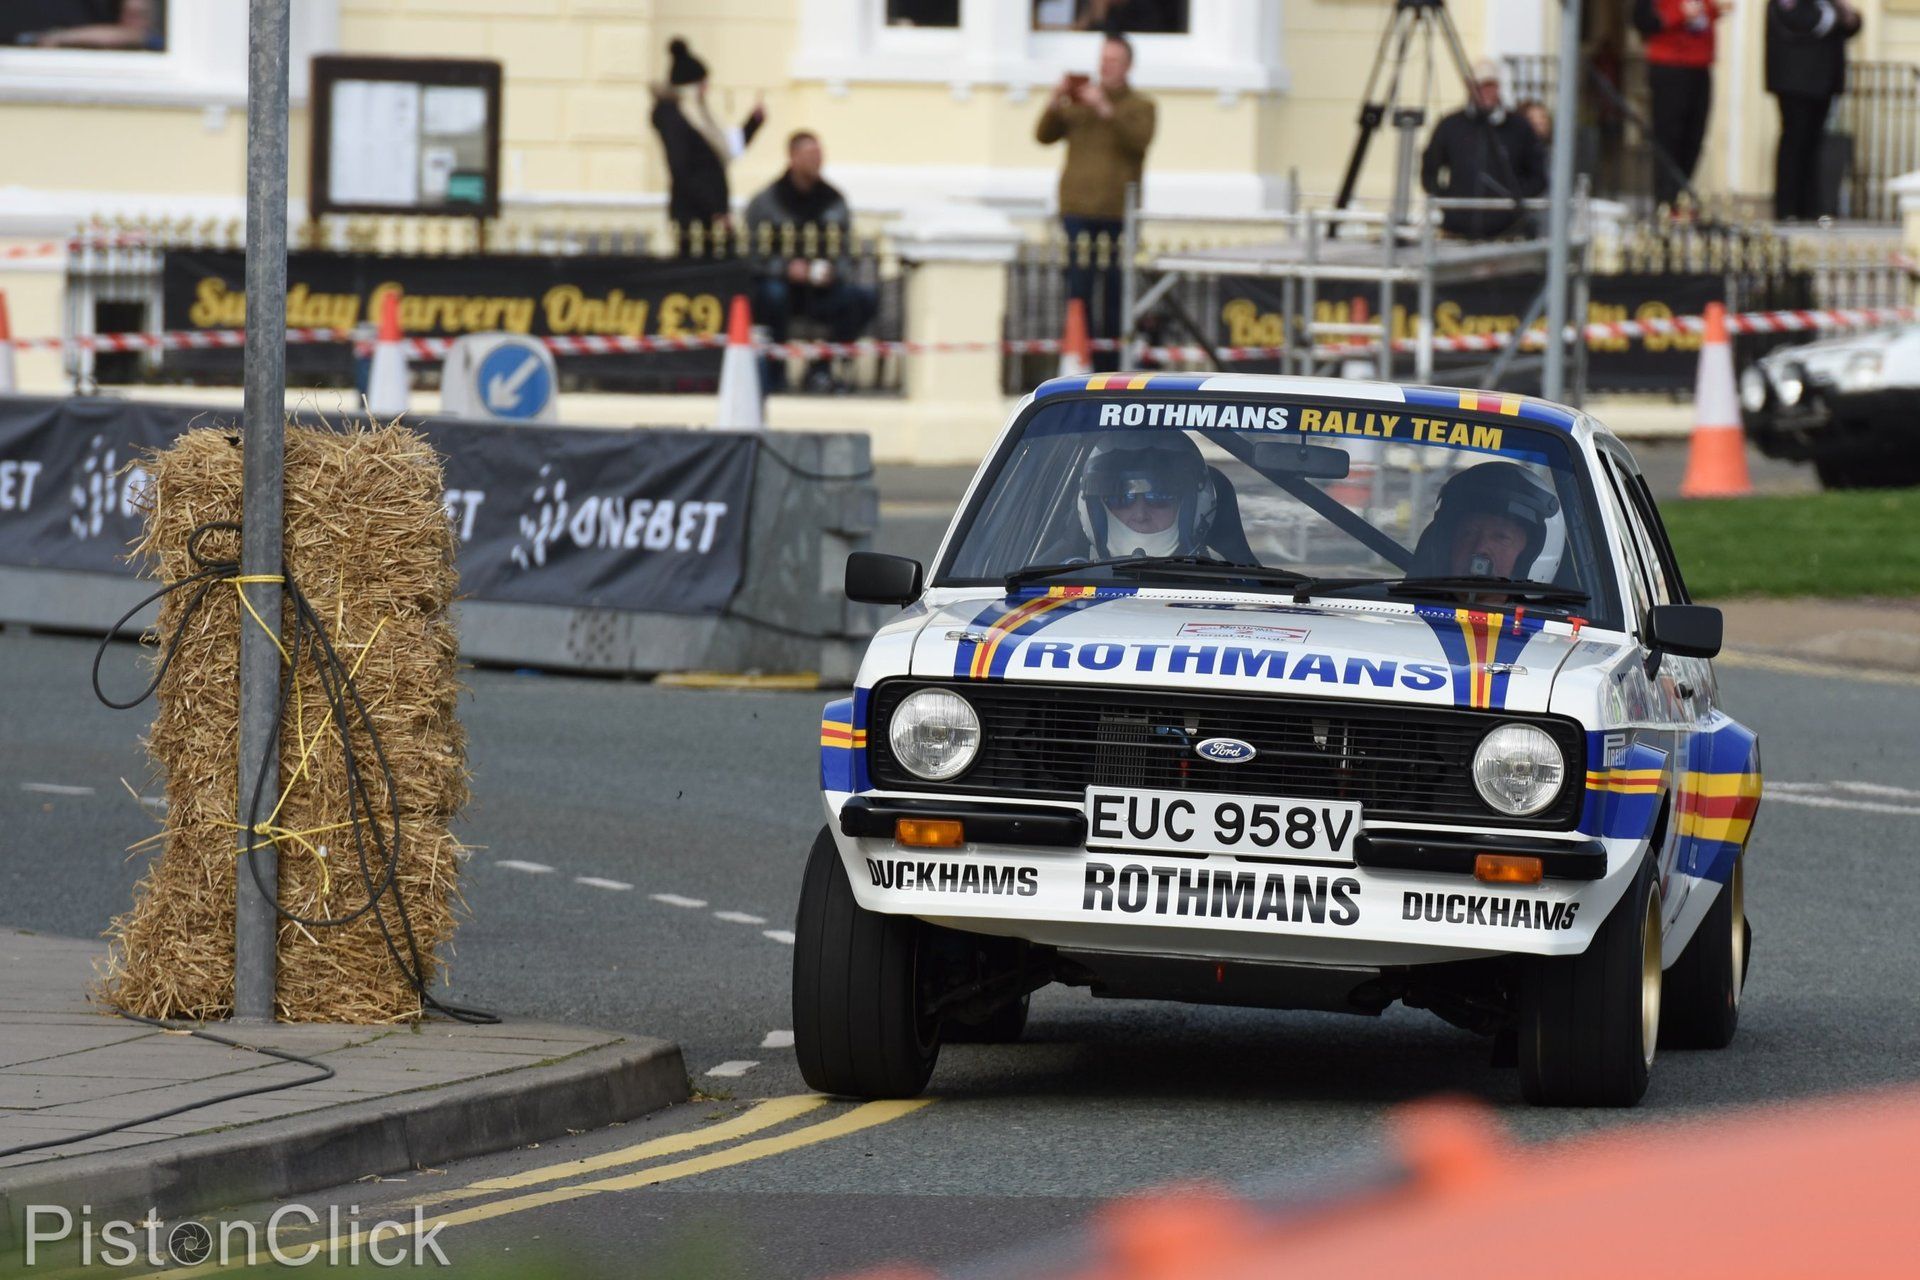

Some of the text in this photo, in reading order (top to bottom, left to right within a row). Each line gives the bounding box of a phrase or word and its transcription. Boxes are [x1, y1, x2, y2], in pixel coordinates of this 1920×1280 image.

[190, 277, 360, 341] Suday
[543, 285, 648, 339] Only
[658, 292, 722, 340] £9
[1099, 403, 1503, 450] ROTHMANS RALLY TEAM
[569, 496, 728, 553] ONEBET
[1023, 641, 1448, 691] ROTHMANS
[1210, 743, 1242, 757] Ford
[1091, 794, 1353, 852] EUC 958V
[866, 857, 1038, 897] DUCKHAMS
[1082, 862, 1361, 926] ROTHMANS
[1402, 891, 1580, 931] DUCKHAMS
